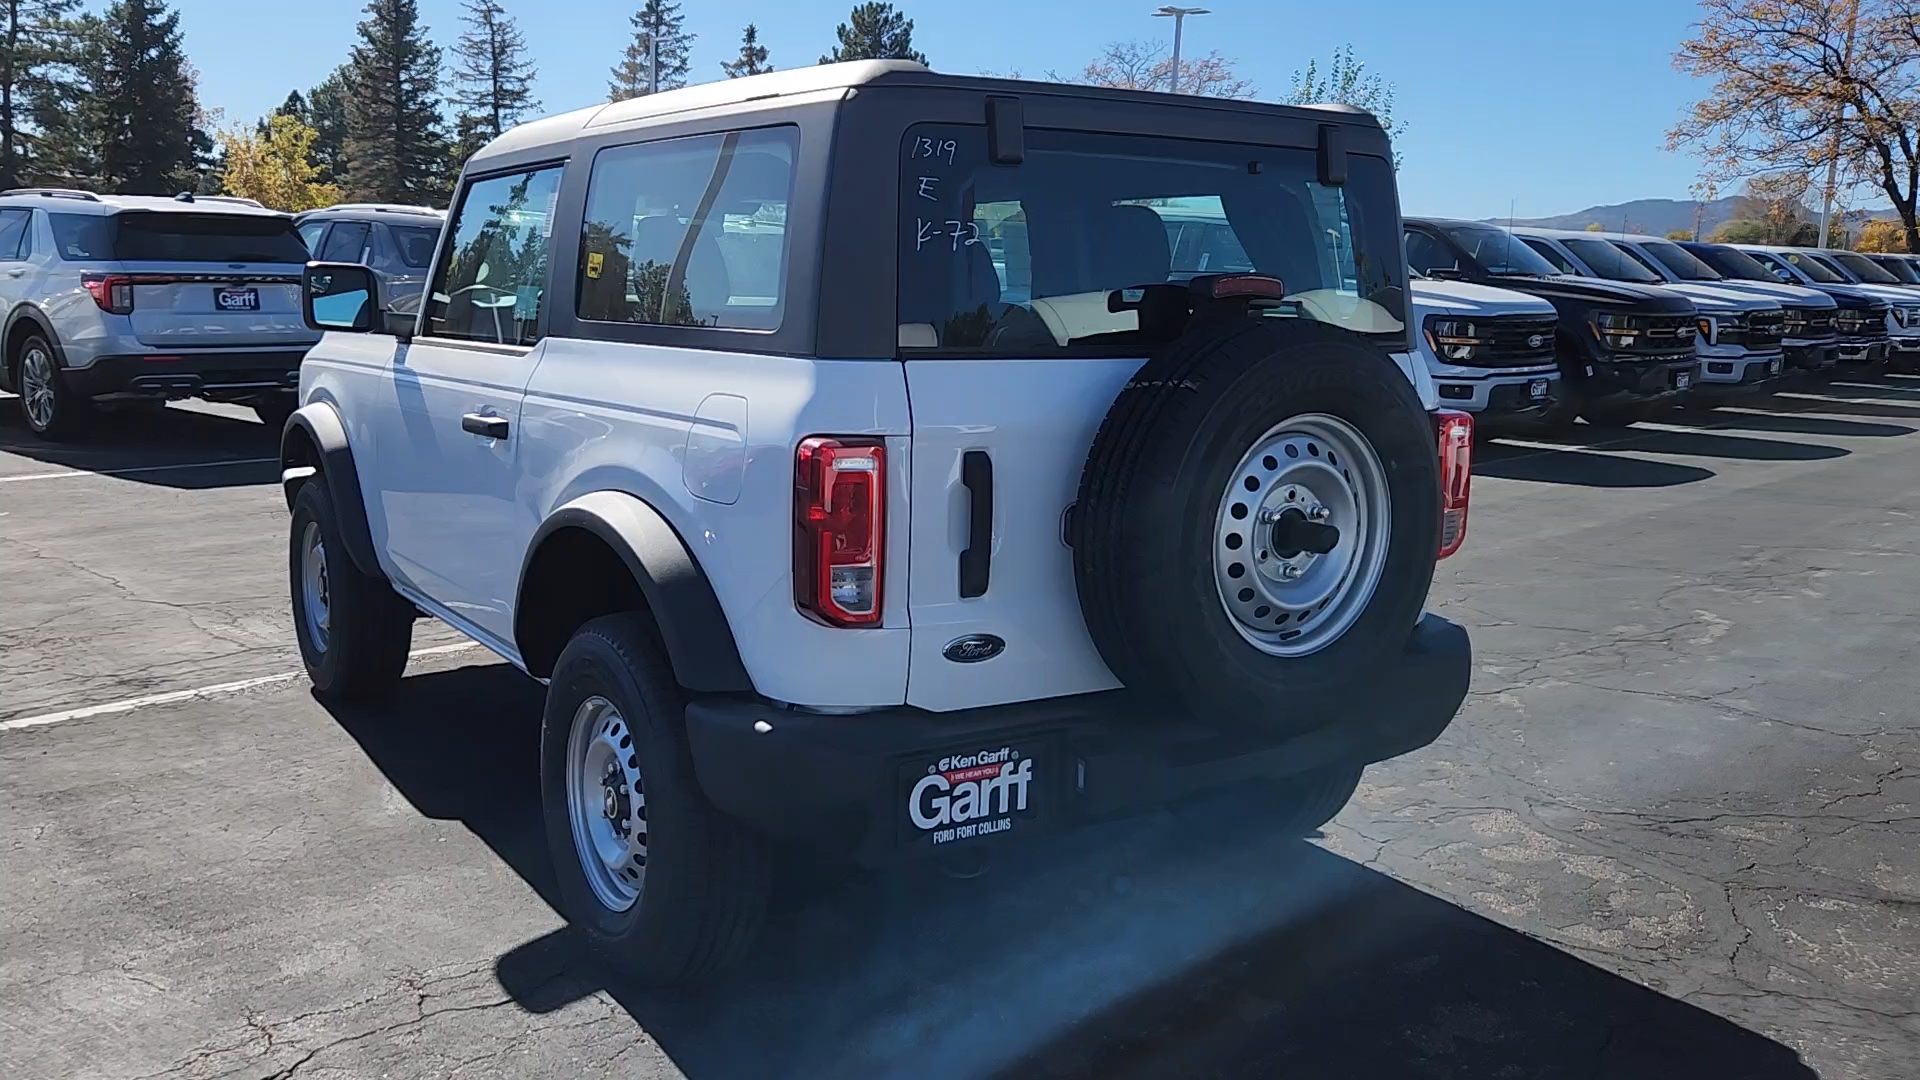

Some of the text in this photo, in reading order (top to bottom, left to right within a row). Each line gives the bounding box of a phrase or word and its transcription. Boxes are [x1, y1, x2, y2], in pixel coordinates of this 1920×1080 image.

[911, 136, 957, 166] 1319
[918, 176, 940, 201] E
[916, 217, 981, 252] K-72
[218, 292, 255, 306] Garff
[958, 640, 993, 657] Ford
[950, 747, 1010, 770] Ken Garff
[955, 767, 995, 781] WE HEAR YOU
[908, 758, 1033, 830] Garff
[933, 817, 1012, 845] FORD FORT COLLINS
